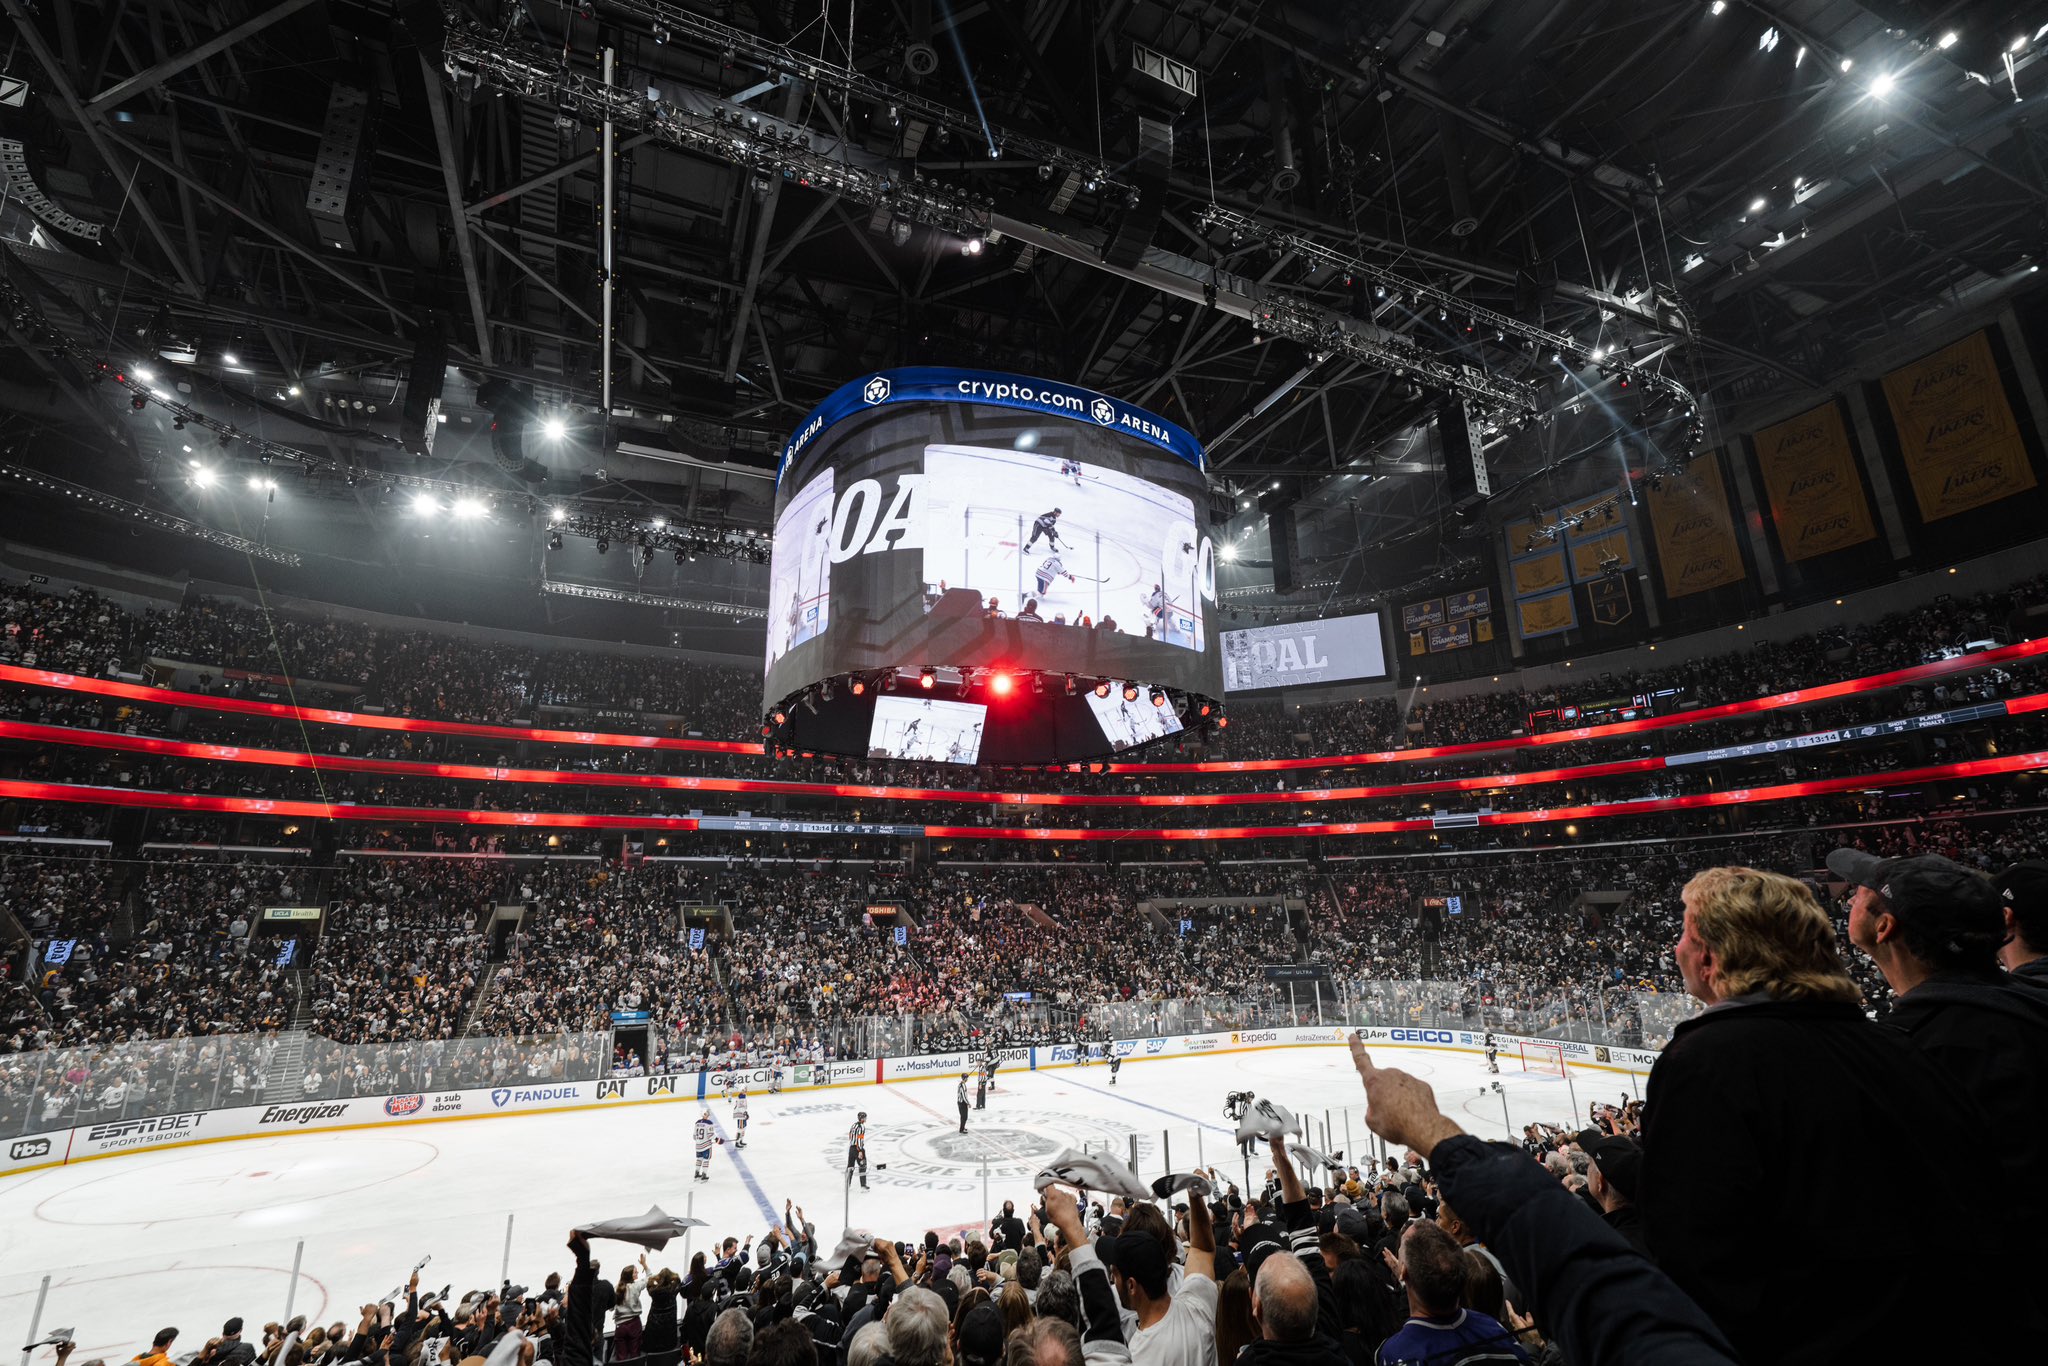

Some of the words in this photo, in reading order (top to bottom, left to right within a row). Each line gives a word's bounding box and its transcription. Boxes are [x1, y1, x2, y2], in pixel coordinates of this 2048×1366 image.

[957, 378, 1085, 412] crypto.com
[794, 415, 823, 455] ARENA
[1120, 413, 1171, 444] ARENA
[1450, 601, 1488, 615] CHAMPIONS
[1406, 612, 1442, 625] CHAMPIONS
[1432, 633, 1469, 646] CHAMPIONS
[1887, 720, 1907, 728] SHOTS
[1918, 718, 1946, 728] PENALTY
[1919, 714, 1942, 722] PLAYER
[1809, 734, 1837, 744] 13:14
[1843, 730, 1851, 739] 4
[1785, 740, 1792, 748] 2
[1241, 1031, 1277, 1044] Expedia
[1295, 1034, 1336, 1042] AstraZeneca
[1390, 1029, 1453, 1044] GEICO
[1116, 1042, 1134, 1053] SAP
[1147, 1040, 1164, 1051] SAP
[907, 1057, 961, 1071] MassMutual
[596, 1079, 628, 1100] CAT
[647, 1076, 678, 1096] CAT
[444, 1093, 461, 1102] sub
[514, 1087, 580, 1102] FANDUEL
[259, 1102, 349, 1124] Energizer
[432, 1103, 462, 1112] above
[99, 1130, 191, 1150] SPORTSBOOK
[12, 1142, 49, 1158] tbs
[894, 1162, 962, 1177] FIRE
